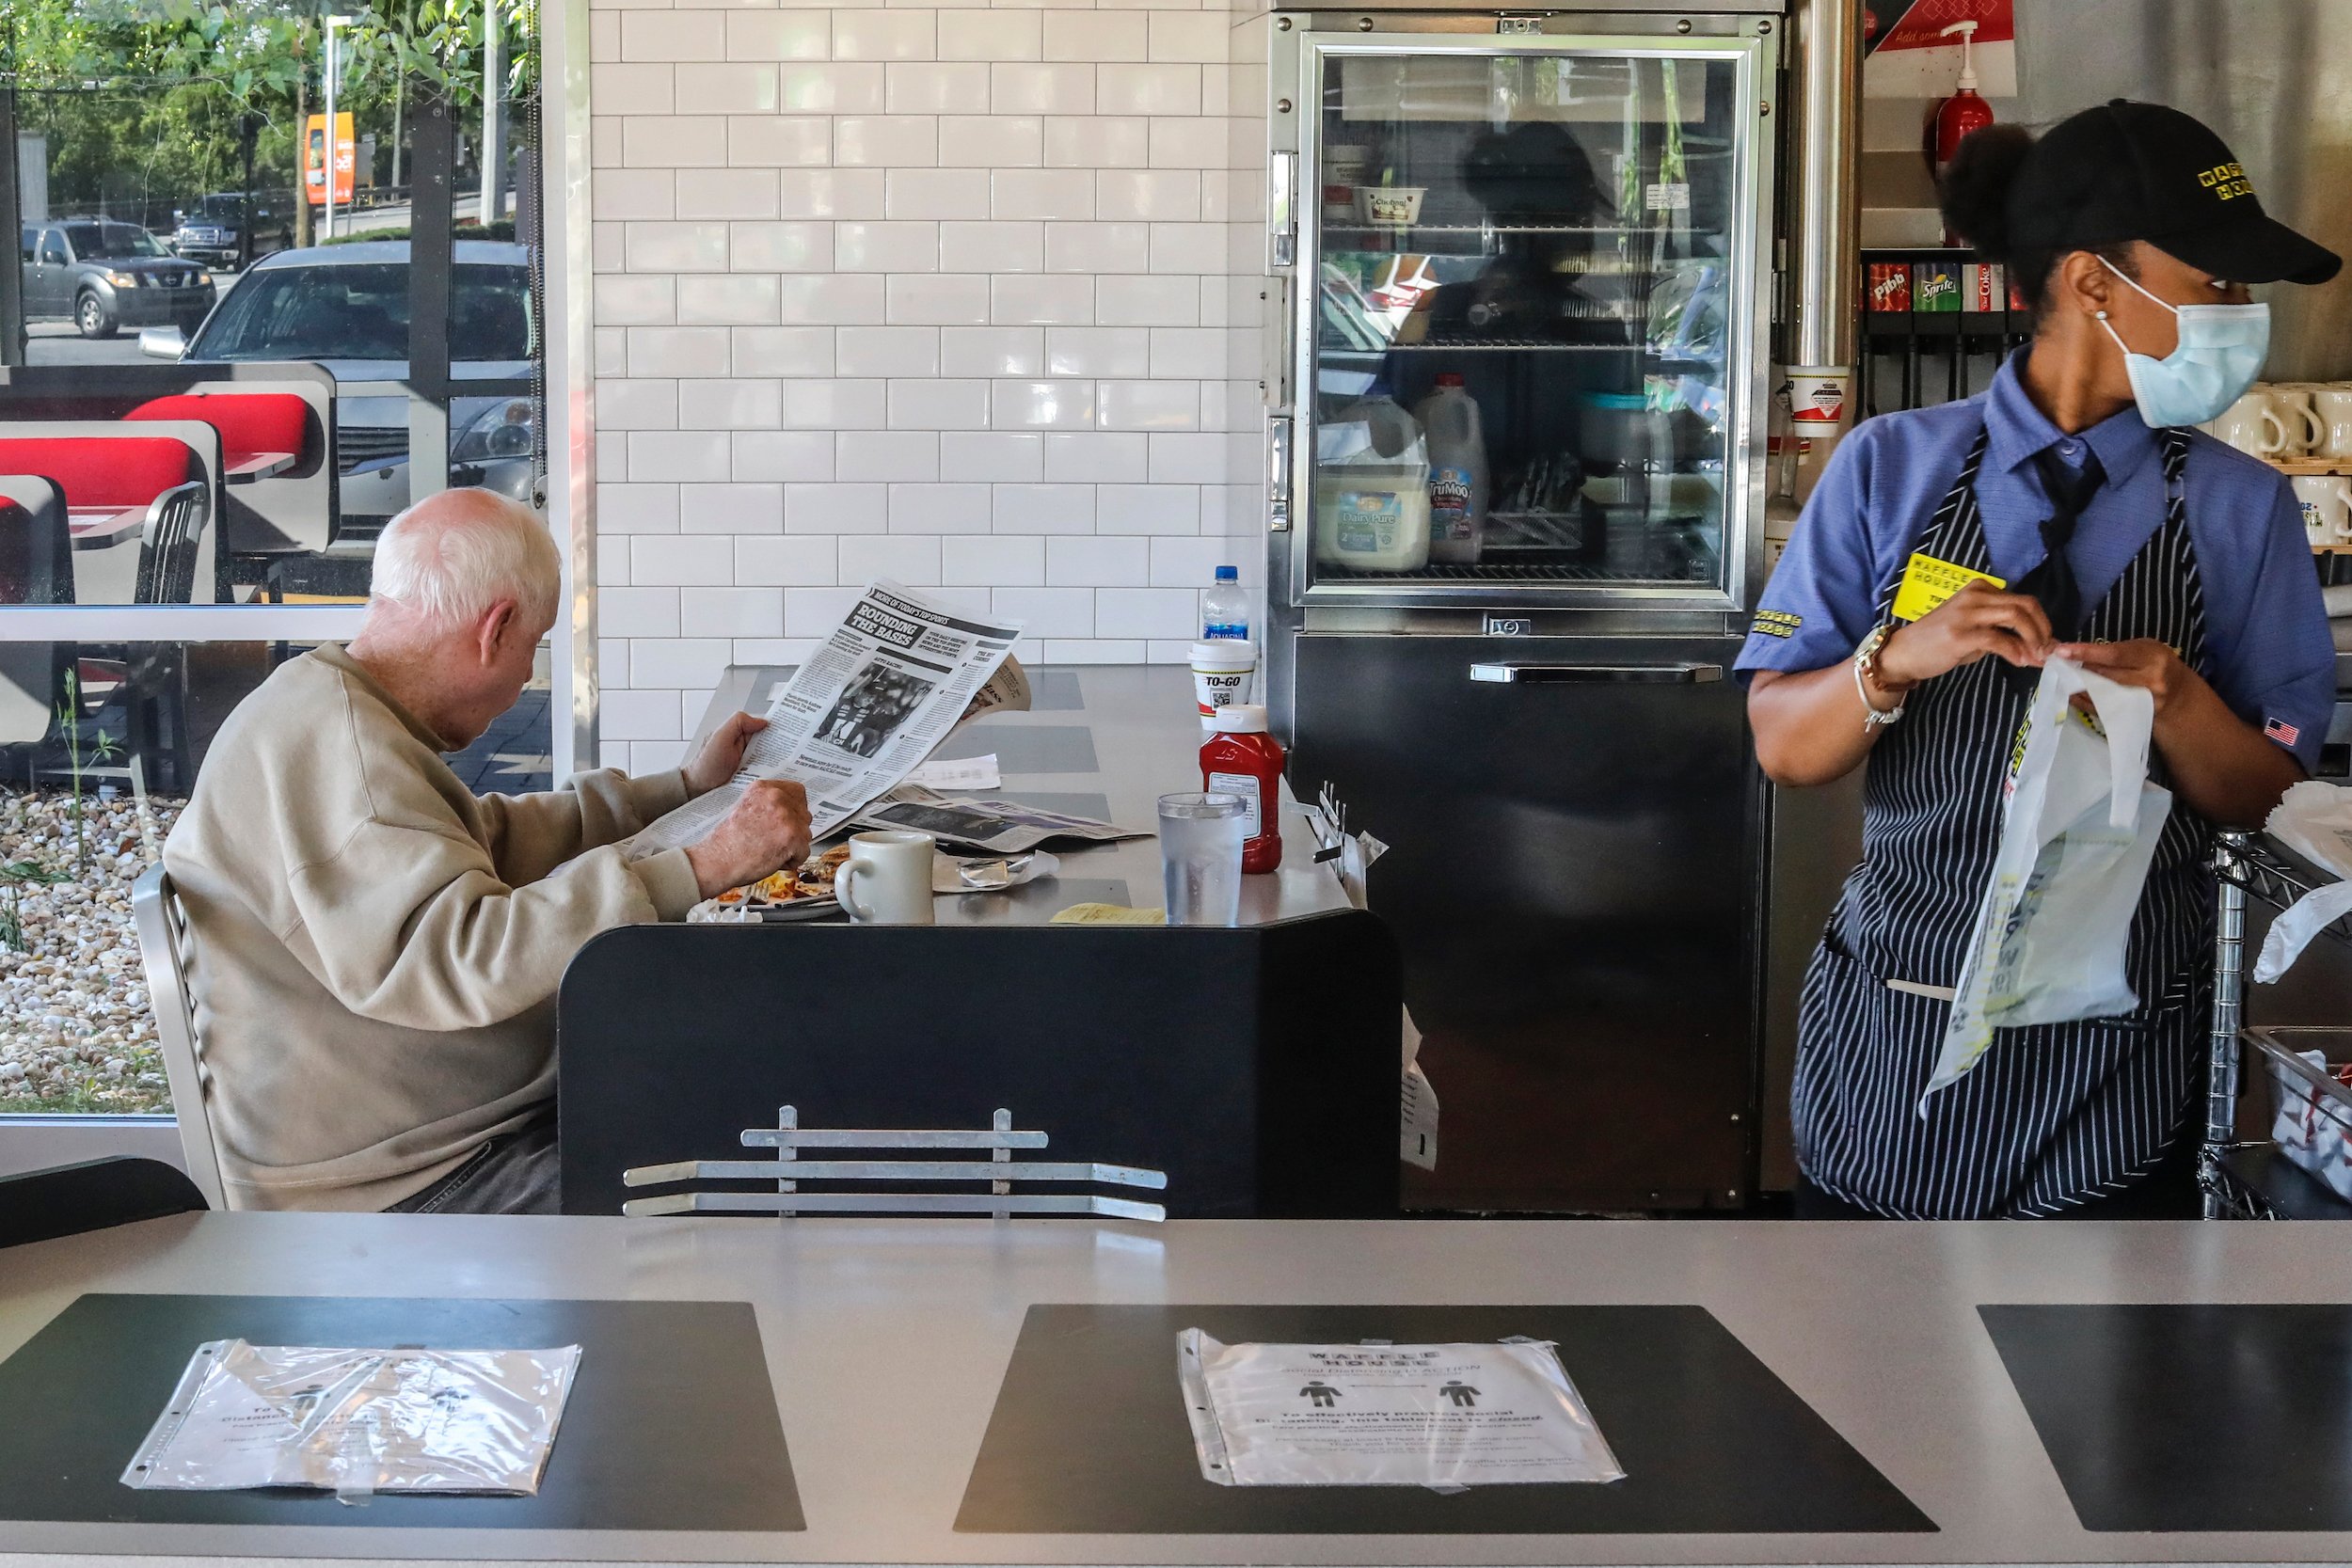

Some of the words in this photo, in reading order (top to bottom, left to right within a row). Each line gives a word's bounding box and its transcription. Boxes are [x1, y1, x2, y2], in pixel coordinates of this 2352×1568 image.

[1923, 278, 1954, 298] Sprite
[1979, 267, 1991, 295] Coke
[857, 604, 918, 635] ROUNDING
[874, 592, 892, 606] MORE
[898, 600, 921, 617] TODAY'S
[918, 610, 930, 621] TOP
[929, 612, 949, 626] SPORTS
[851, 615, 879, 635] THE
[875, 624, 914, 646] BASES
[1206, 676, 1241, 687] TO-GO
[1309, 1352, 1440, 1360] WAFFLE
